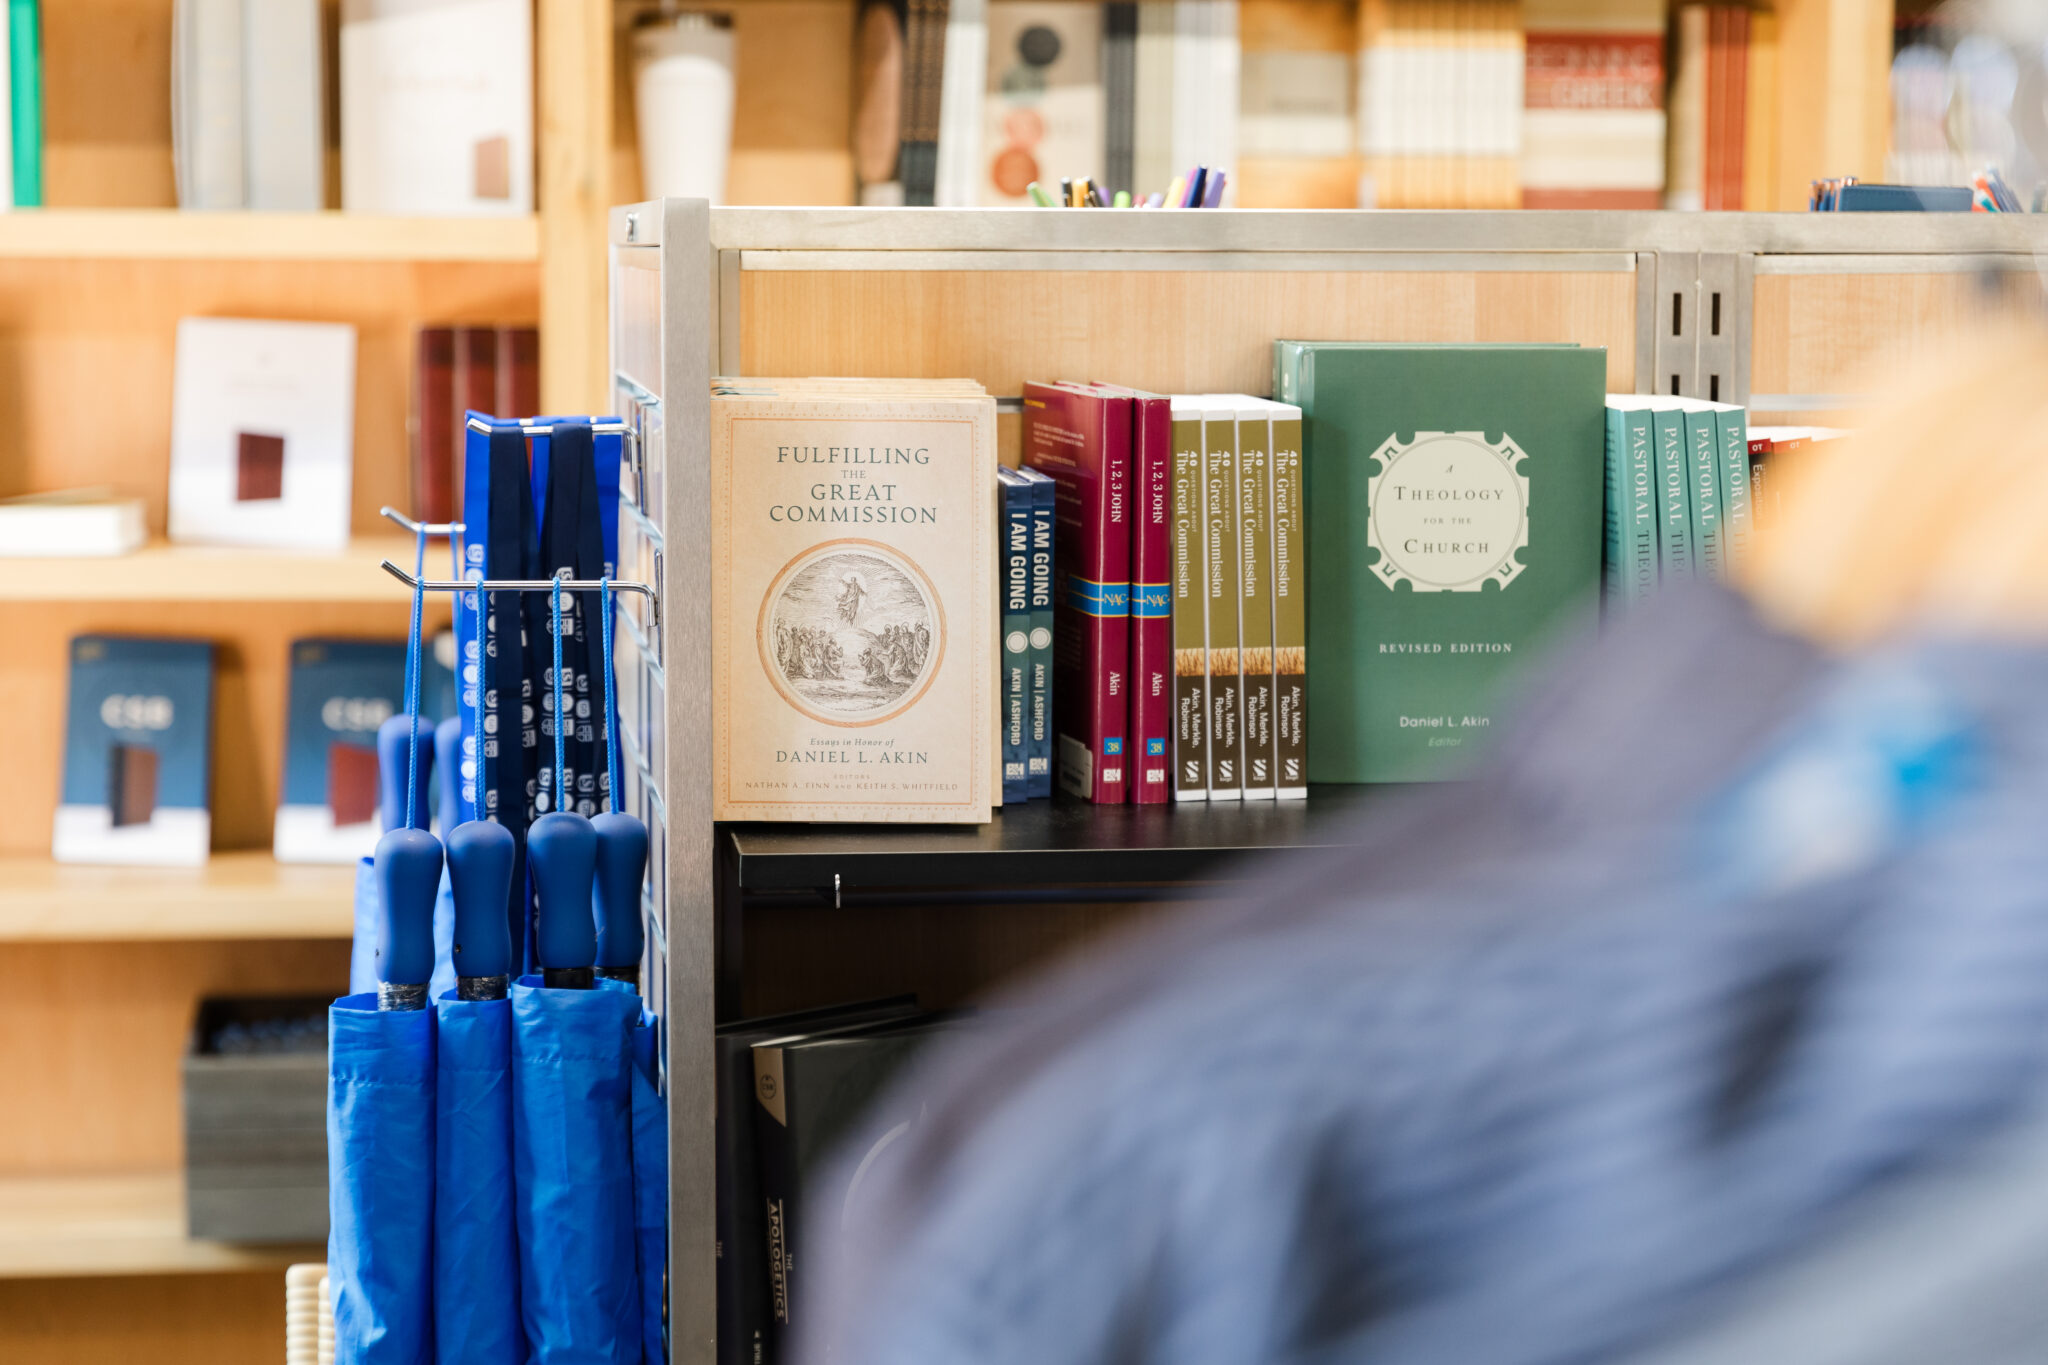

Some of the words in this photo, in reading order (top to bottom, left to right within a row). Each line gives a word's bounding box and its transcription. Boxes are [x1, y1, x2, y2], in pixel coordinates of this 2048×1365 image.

[776, 446, 930, 465] FULFILLING
[1190, 451, 1197, 467] 40
[1223, 451, 1230, 467] 40
[1256, 450, 1263, 466] 40
[1290, 450, 1297, 466] 40
[1752, 443, 1763, 452] OT
[841, 469, 867, 479] THE
[1111, 460, 1122, 468] 1,
[1152, 461, 1163, 470] 1,
[1177, 450, 1188, 475] The
[1210, 450, 1221, 475] The
[1243, 449, 1255, 474] The
[1276, 449, 1288, 474] The
[1446, 464, 1453, 473] A
[1111, 471, 1122, 481] 2,
[1152, 472, 1163, 482] 2,
[1633, 426, 1649, 525] PASTORAL
[1664, 427, 1682, 525] PASTORAL
[1696, 427, 1715, 526] PASTORAL
[1727, 426, 1745, 524] PASTORAL
[811, 483, 897, 501] GREAT
[1177, 479, 1189, 514] Great
[1210, 479, 1222, 514] Great
[1243, 478, 1255, 514] Great
[1276, 478, 1289, 514] Great
[769, 505, 937, 523] COMMISSION
[1112, 492, 1122, 523] JOHN
[1152, 494, 1163, 524] JOHN
[1011, 522, 1027, 551] AM
[1034, 520, 1050, 548] AM
[1178, 520, 1190, 597] Commission
[1211, 520, 1223, 597] Commission
[1244, 519, 1256, 597] Commission
[1277, 518, 1290, 596] Commission
[1010, 555, 1027, 609] GOING
[1033, 553, 1049, 606] GOING
[1104, 593, 1126, 606] NAC
[1146, 594, 1168, 607] NAC
[1379, 644, 1442, 653] REVISED
[1450, 643, 1512, 653] EDITION
[1011, 667, 1022, 692] AKIN
[1035, 663, 1045, 688] AKIN
[1109, 671, 1120, 696] Akin
[1152, 672, 1163, 696] Akin
[1192, 688, 1200, 711] Akin,
[1225, 687, 1234, 711] Akin,
[1259, 686, 1268, 710] Akin,
[1292, 686, 1300, 710] Akin,
[1011, 699, 1021, 745] ASHFORD
[1034, 695, 1044, 740] ASHFORD
[1181, 698, 1190, 740] Robinson
[1215, 697, 1224, 739] Robinson
[1248, 696, 1258, 738] Robinson
[1259, 712, 1268, 747] Merkle,
[1281, 696, 1290, 738] Robinson
[1292, 712, 1301, 747] Merkle,
[1400, 716, 1443, 727] Daniel
[1448, 716, 1458, 727] L.
[1461, 716, 1489, 727] Akin
[810, 738, 840, 746] Essays
[843, 738, 851, 746] in
[854, 738, 882, 746] Honor
[885, 738, 895, 747] of
[1192, 713, 1201, 748] Merkle,
[1225, 713, 1235, 748] Merkle,
[1428, 737, 1462, 747] Editor
[776, 750, 850, 763] DANIEL
[858, 751, 873, 764] L.
[880, 751, 928, 764] AKIN
[1107, 742, 1119, 752] 38
[1151, 743, 1162, 754] 38
[770, 1204, 784, 1318] APOLOGETICS
